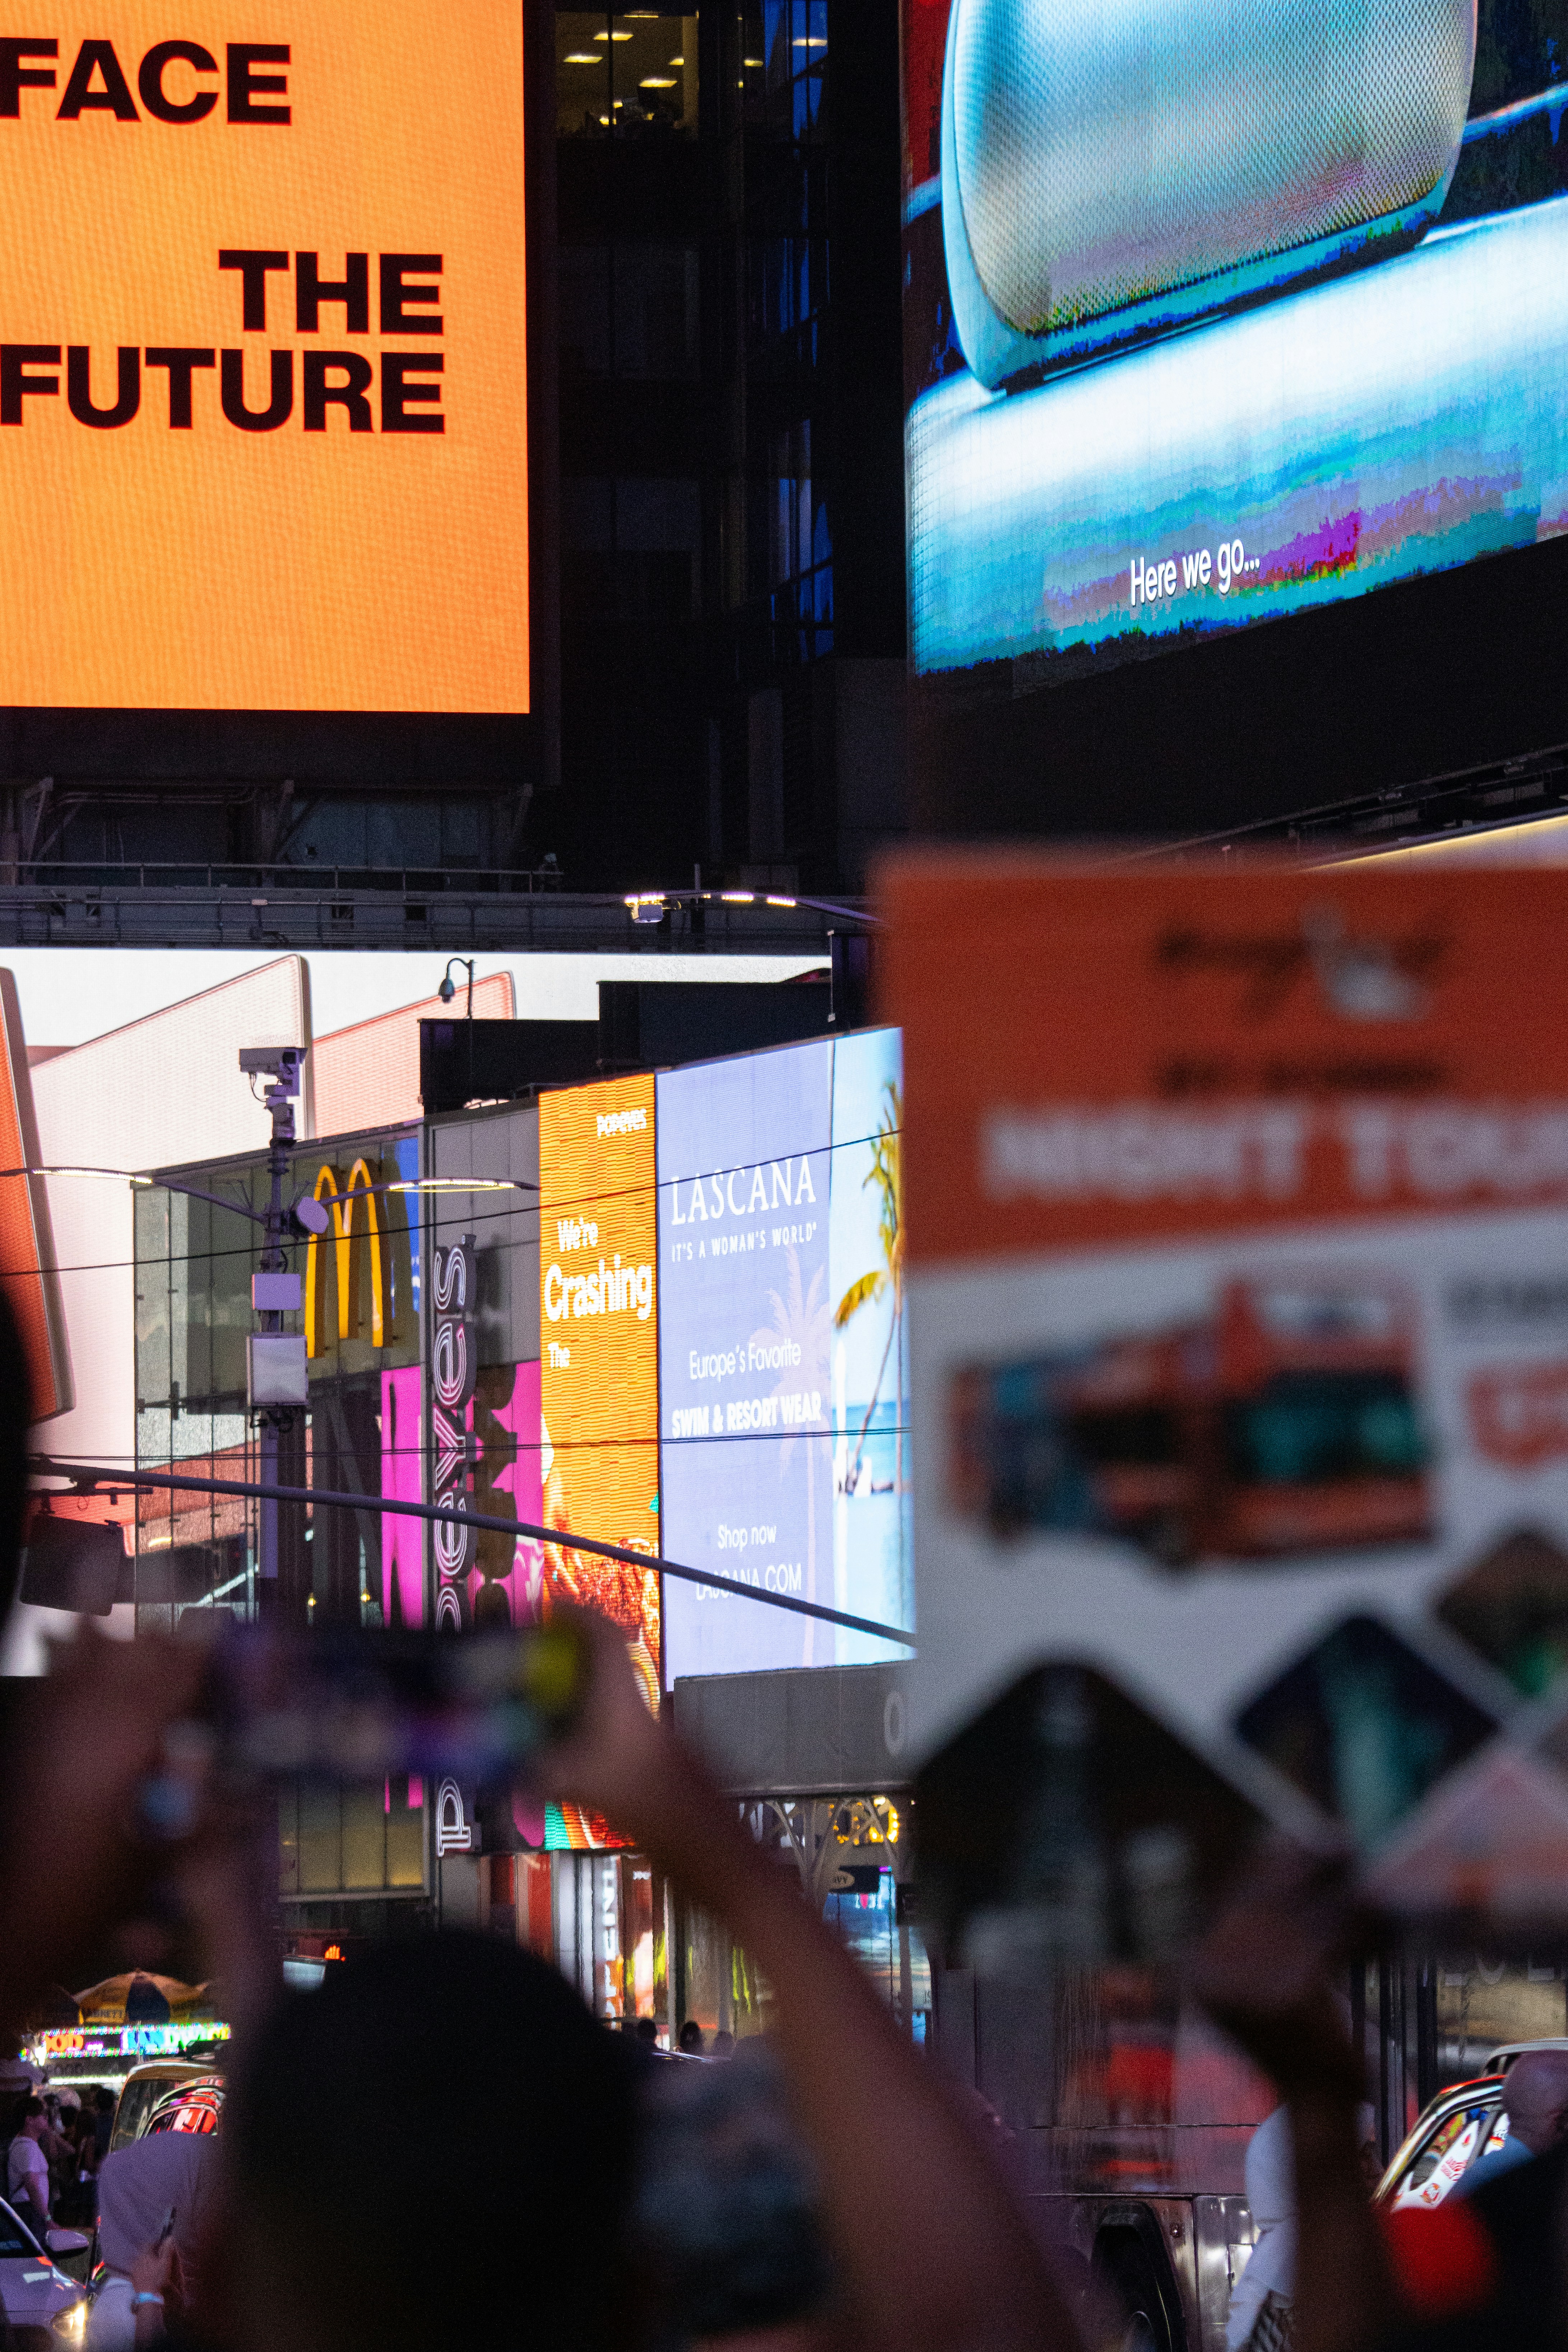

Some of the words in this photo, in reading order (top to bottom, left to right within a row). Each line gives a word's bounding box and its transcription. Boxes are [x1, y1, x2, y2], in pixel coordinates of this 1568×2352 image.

[0, 37, 292, 126] FACE
[218, 249, 444, 336] THE
[0, 343, 446, 434] FUTURE
[1131, 556, 1177, 606] Here
[1182, 549, 1212, 590] we
[1218, 539, 1260, 594] go...
[671, 1155, 817, 1225] LASCANA
[557, 1216, 599, 1252] We're
[672, 1242, 693, 1262] IT'S
[699, 1240, 706, 1258] A
[711, 1230, 766, 1256] WOMAN'S
[544, 1254, 653, 1322] Crashing
[547, 1342, 571, 1369] The
[689, 1345, 746, 1383] Europe's
[748, 1337, 802, 1372] Favorite
[672, 1405, 710, 1439] SWIM
[712, 1404, 724, 1434] &
[726, 1396, 779, 1432] RESORT
[780, 1391, 822, 1425] WEAR
[718, 1524, 748, 1553] Shop
[751, 1525, 777, 1545] now
